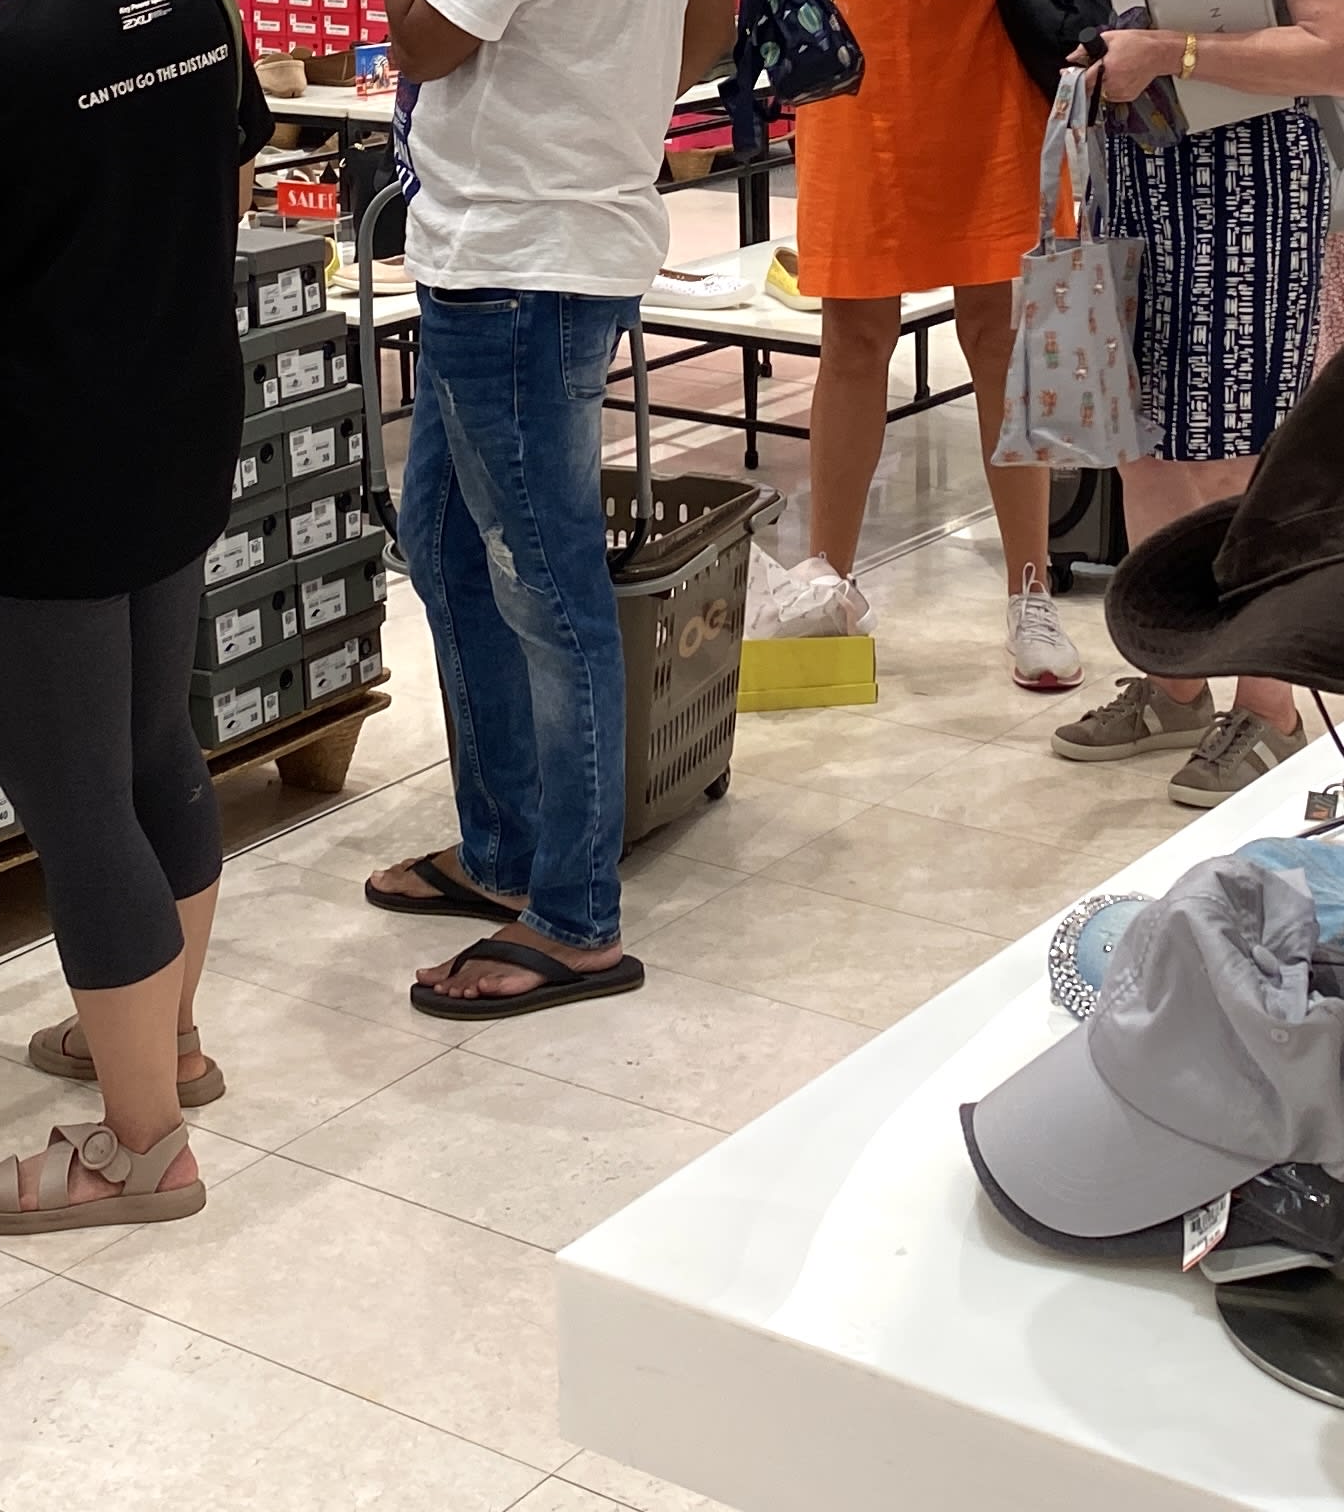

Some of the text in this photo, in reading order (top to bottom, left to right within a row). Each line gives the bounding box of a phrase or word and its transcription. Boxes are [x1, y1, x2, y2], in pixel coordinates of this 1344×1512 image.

[122, 14, 152, 30] 2XU
[77, 87, 110, 110] CAN
[110, 77, 135, 99] YOU
[135, 71, 155, 89] GO
[156, 63, 179, 83] THE
[678, 598, 728, 659] OG
